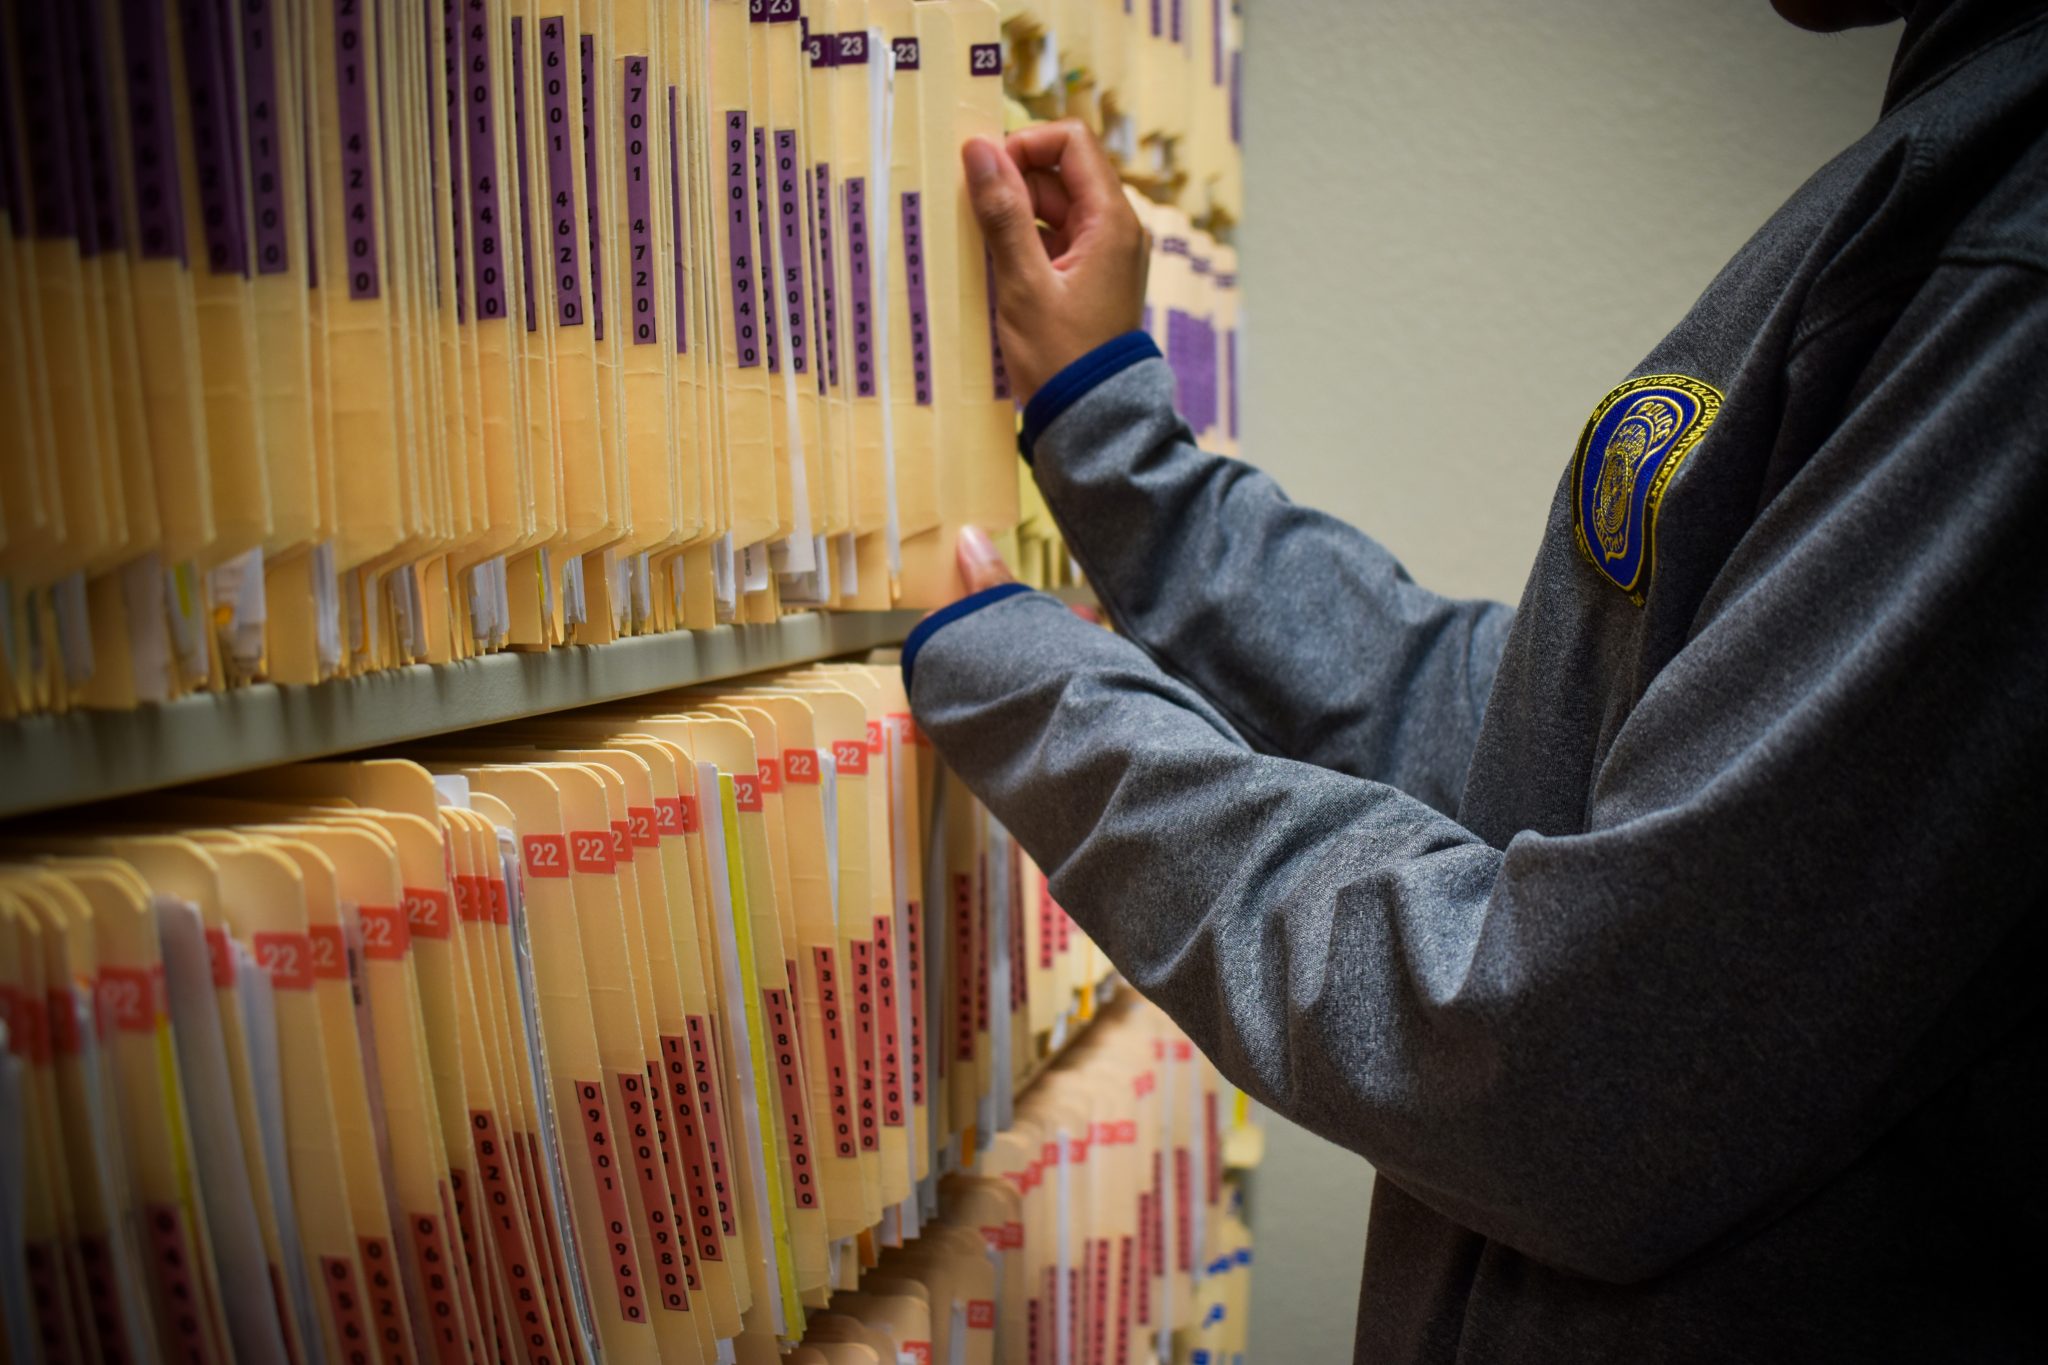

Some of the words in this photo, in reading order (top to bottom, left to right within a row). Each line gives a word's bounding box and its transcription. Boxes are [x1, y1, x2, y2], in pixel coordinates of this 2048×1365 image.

[770, 0, 793, 14] 23
[842, 37, 862, 57] 23
[896, 44, 917, 62] 23
[974, 49, 997, 69] 23
[630, 61, 643, 182] 47001
[348, 133, 370, 293] 42400
[544, 23, 563, 152] 46001
[556, 191, 577, 319] 46200
[730, 116, 744, 223] 49201
[478, 176, 498, 316] 44800
[780, 135, 794, 237] 50601
[787, 268, 804, 370] 50800
[851, 182, 864, 274] 52801
[907, 195, 919, 285] 53201
[633, 218, 650, 339] 47200
[736, 255, 756, 358] 49400
[857, 302, 870, 391] 53000
[1632, 377, 1687, 390] RIVER
[1636, 401, 1673, 444] POLICE
[760, 765, 773, 785] 2
[789, 754, 812, 777] 22
[838, 747, 859, 767] 22
[530, 843, 559, 867] 22
[577, 838, 607, 861] 22
[361, 916, 393, 948] 22
[406, 896, 438, 927] 22
[262, 942, 301, 977] 22
[859, 944, 870, 1032] 13401
[821, 951, 837, 1040] 13201
[833, 1066, 850, 1154] 13400
[877, 919, 890, 1008] 14001
[886, 1034, 900, 1122] 14200
[690, 1019, 712, 1114] 11201
[709, 1141, 731, 1233] 11400
[772, 993, 793, 1086] 11801
[791, 1114, 813, 1206] 12000
[863, 1060, 873, 1147] 13600
[475, 1113, 512, 1230] 08201
[625, 1078, 654, 1181] 09601
[651, 1210, 681, 1306] 09800
[668, 1040, 693, 1137] 10801
[692, 1165, 717, 1257] 11000
[583, 1086, 613, 1191] 09401
[611, 1220, 640, 1319] 09600
[418, 1217, 455, 1345] 06801
